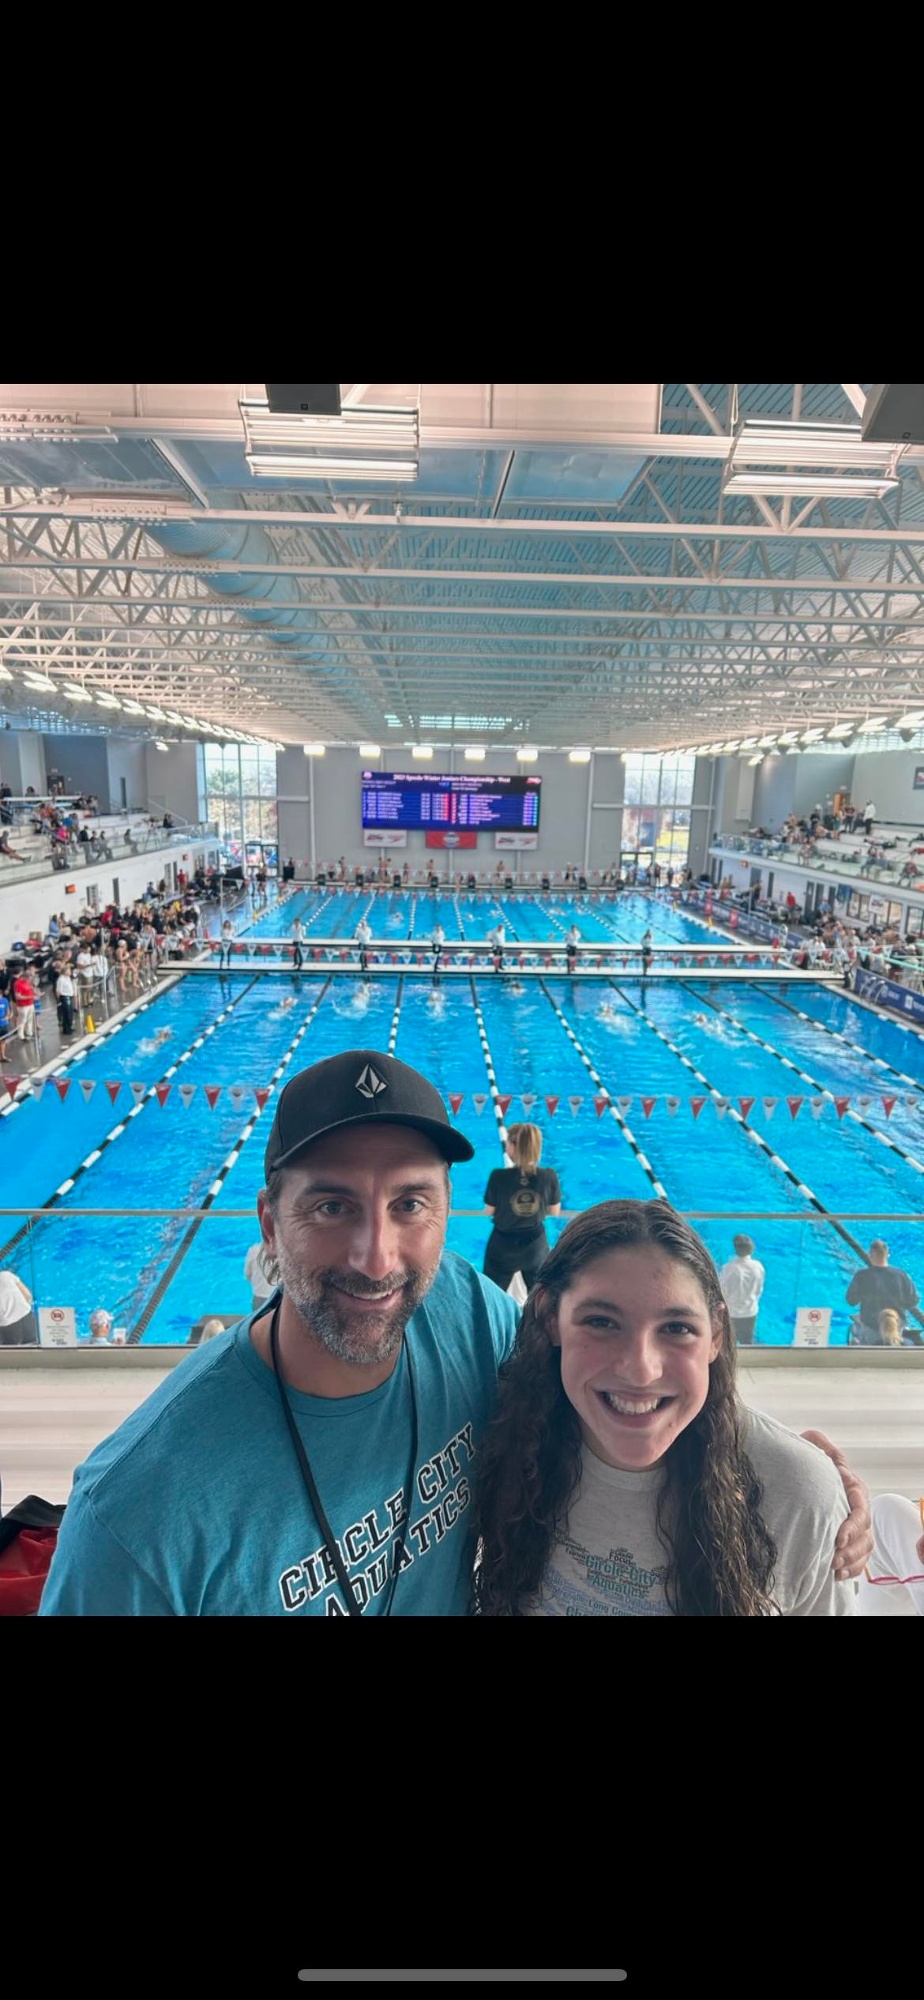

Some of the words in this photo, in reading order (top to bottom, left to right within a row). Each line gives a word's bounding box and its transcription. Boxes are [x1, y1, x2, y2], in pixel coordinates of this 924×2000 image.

[279, 1486, 408, 1612] CIRCLE
[416, 1421, 476, 1504] CITY
[593, 1574, 645, 1599] Aquatics
